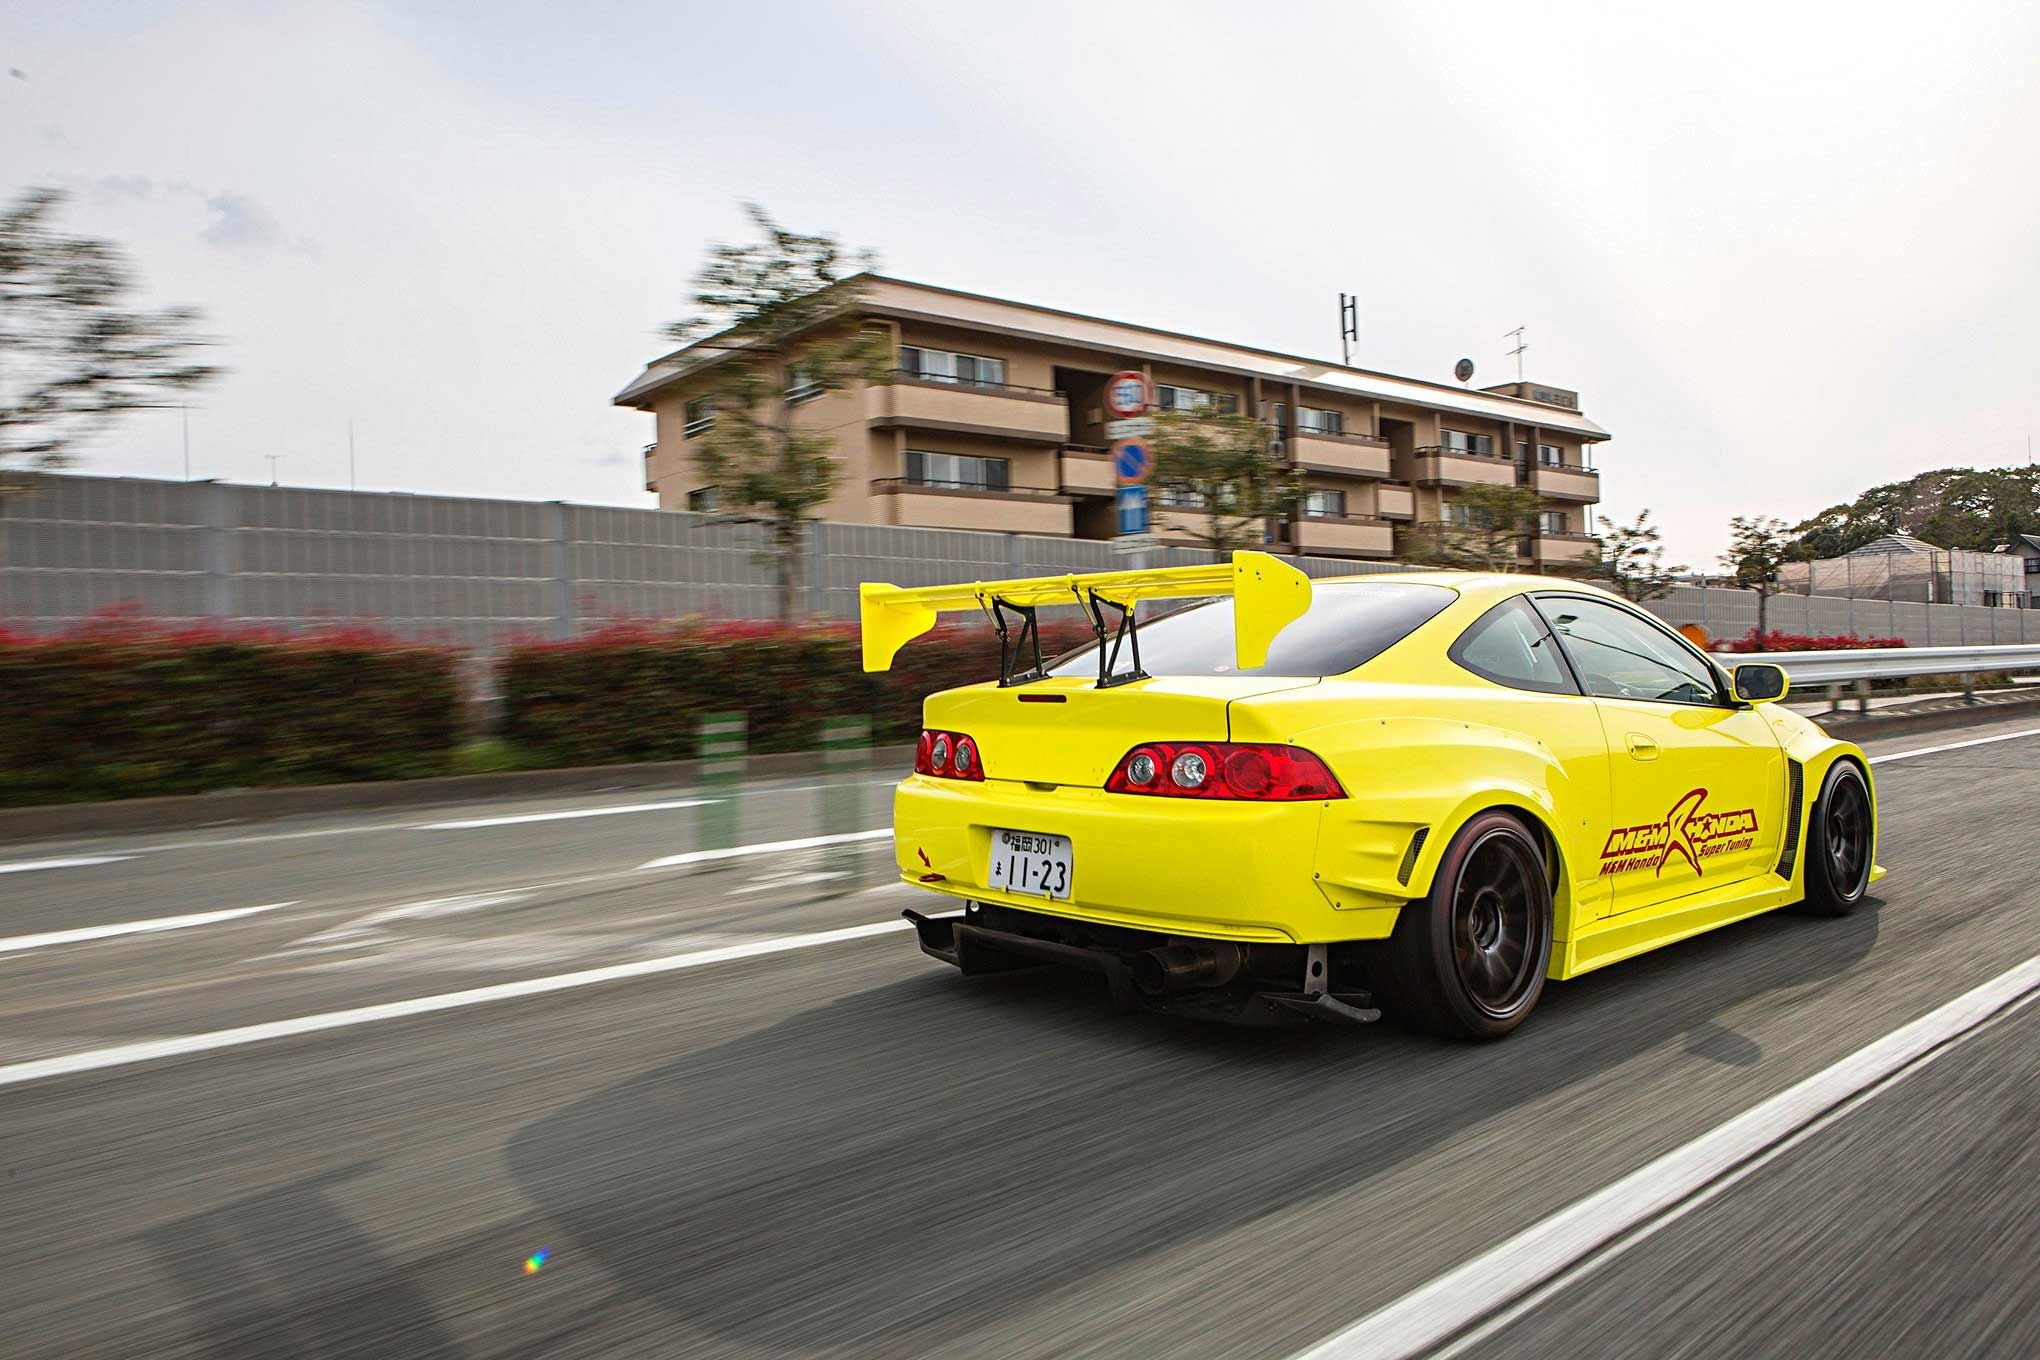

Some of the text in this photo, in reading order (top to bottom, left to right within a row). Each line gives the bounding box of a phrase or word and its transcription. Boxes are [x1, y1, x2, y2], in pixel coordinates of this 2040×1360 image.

[1684, 811, 1756, 841] HONDA
[1625, 854, 1661, 872] Honda
[1698, 843, 1726, 858] Super
[1725, 837, 1754, 851] Tuning
[1009, 855, 1066, 892] 11-23
